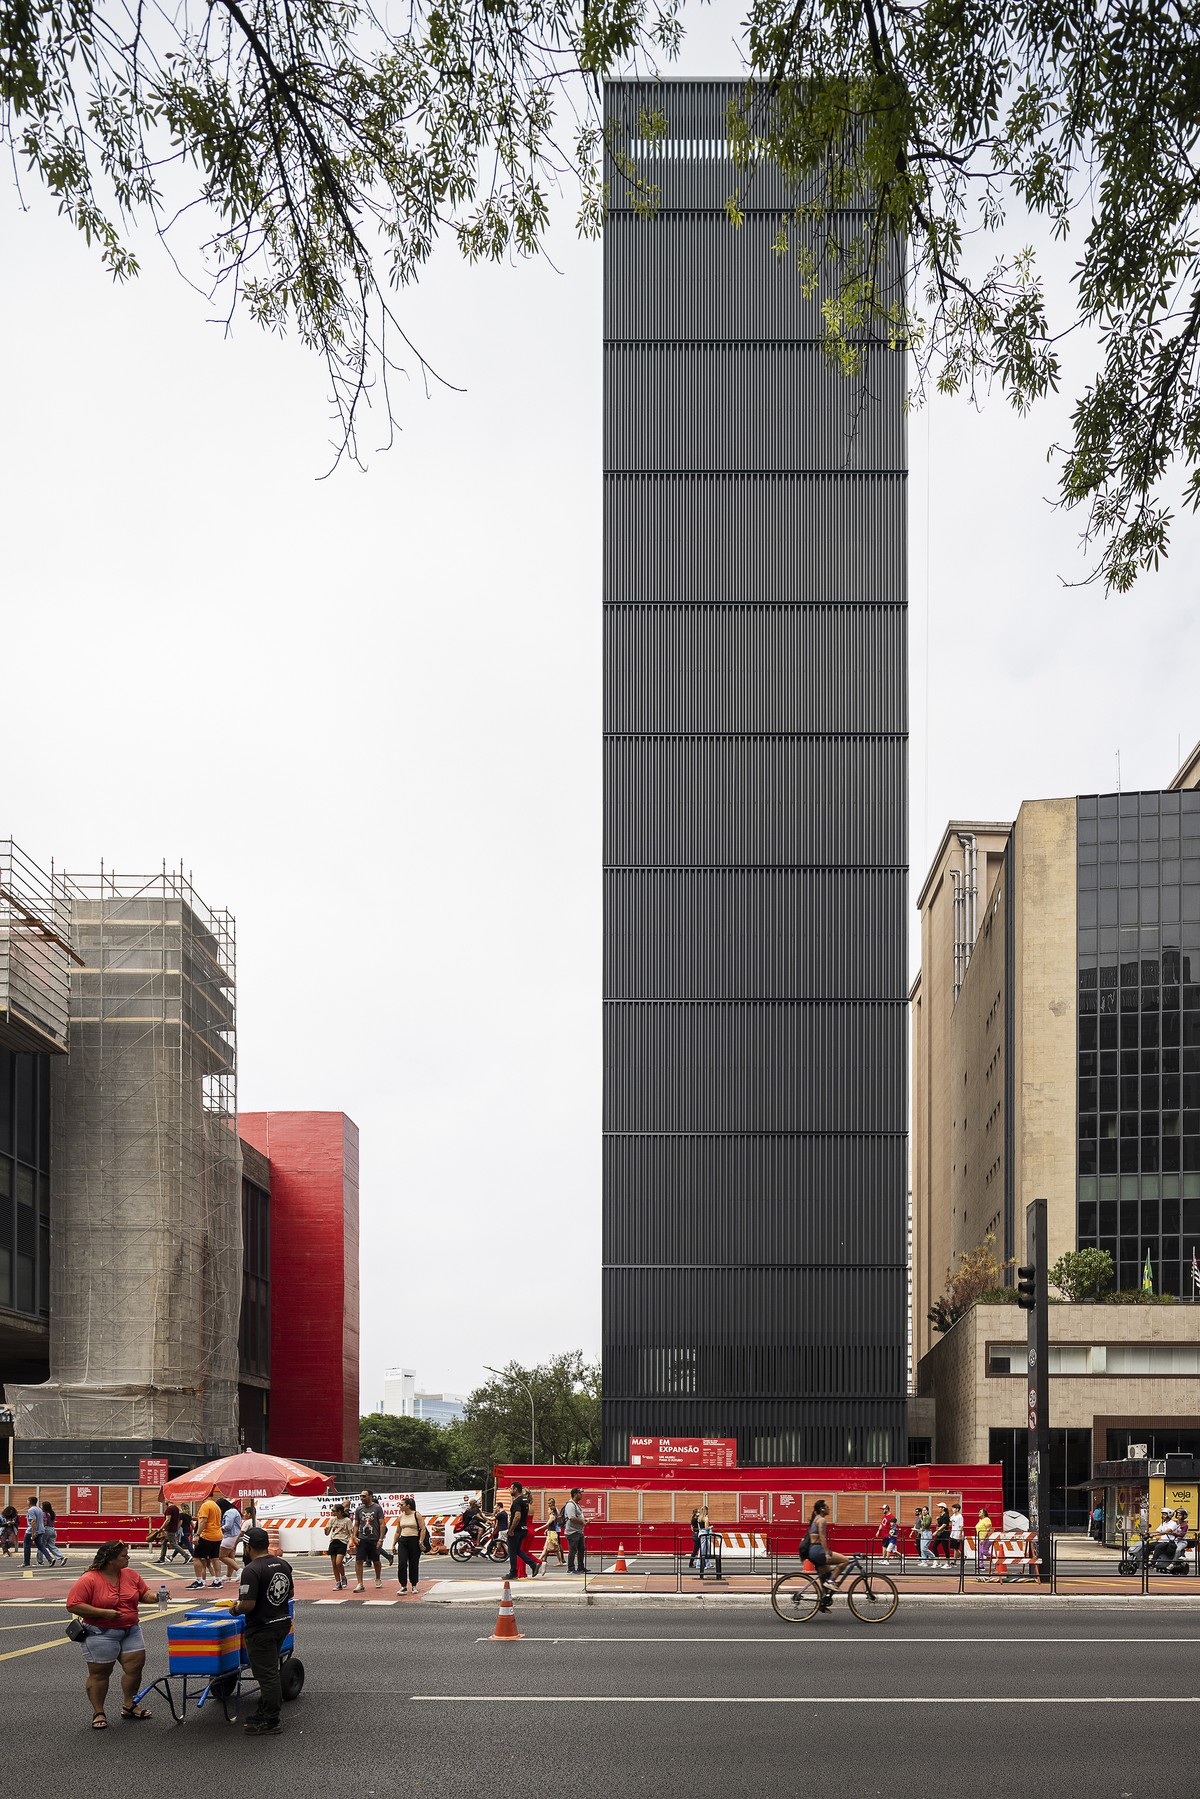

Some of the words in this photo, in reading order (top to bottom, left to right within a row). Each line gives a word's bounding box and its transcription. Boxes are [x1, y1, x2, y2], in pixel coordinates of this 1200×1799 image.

[631, 1438, 653, 1446] MASP
[659, 1445, 700, 1453] EXPANSÃO
[238, 1489, 267, 1497] BRAHMA
[388, 1493, 415, 1501] OBRAS
[1172, 1490, 1191, 1500] veja
